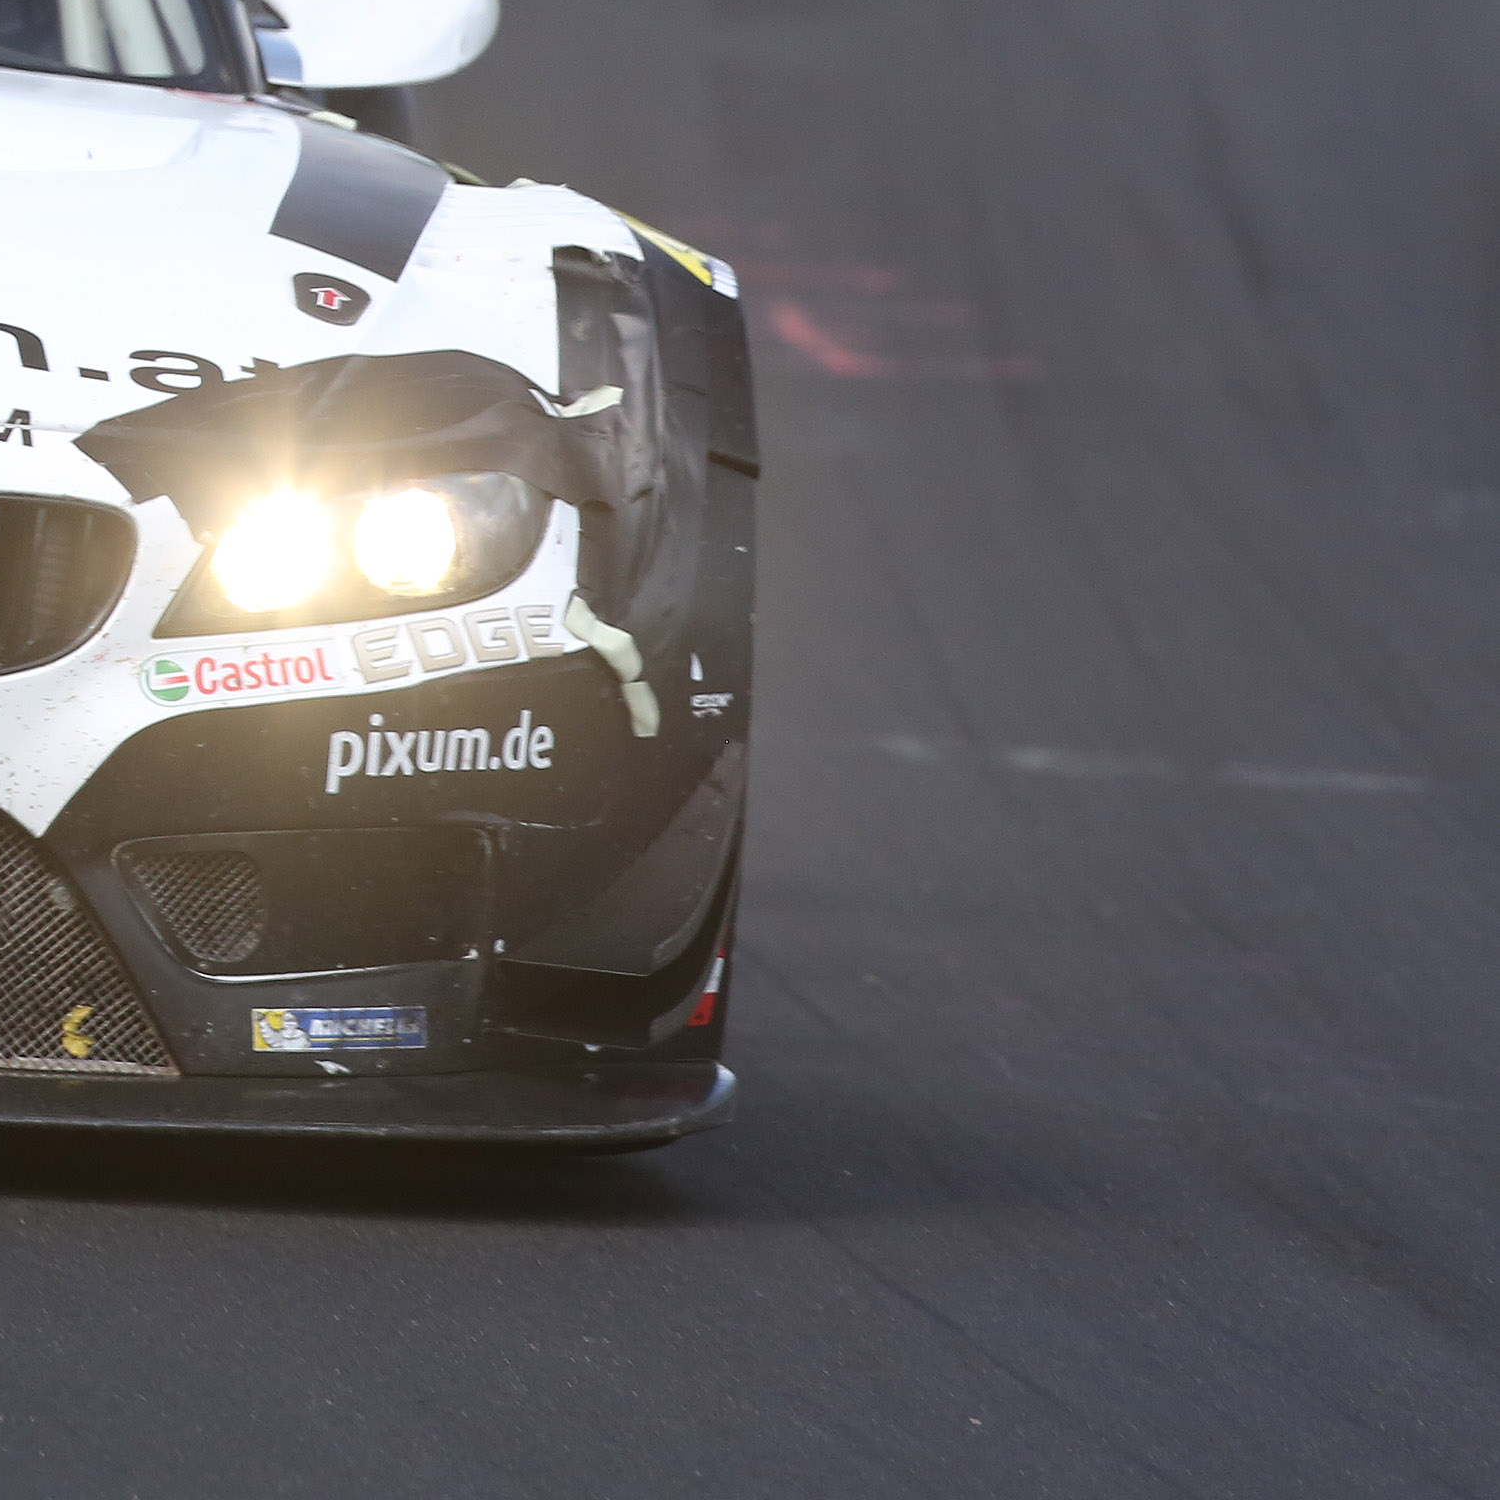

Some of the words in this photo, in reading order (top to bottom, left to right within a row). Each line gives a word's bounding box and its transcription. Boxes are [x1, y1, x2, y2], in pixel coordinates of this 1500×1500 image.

[193, 646, 333, 696] Castrol
[350, 603, 566, 685] EDGE
[324, 708, 556, 795] pixum.de
